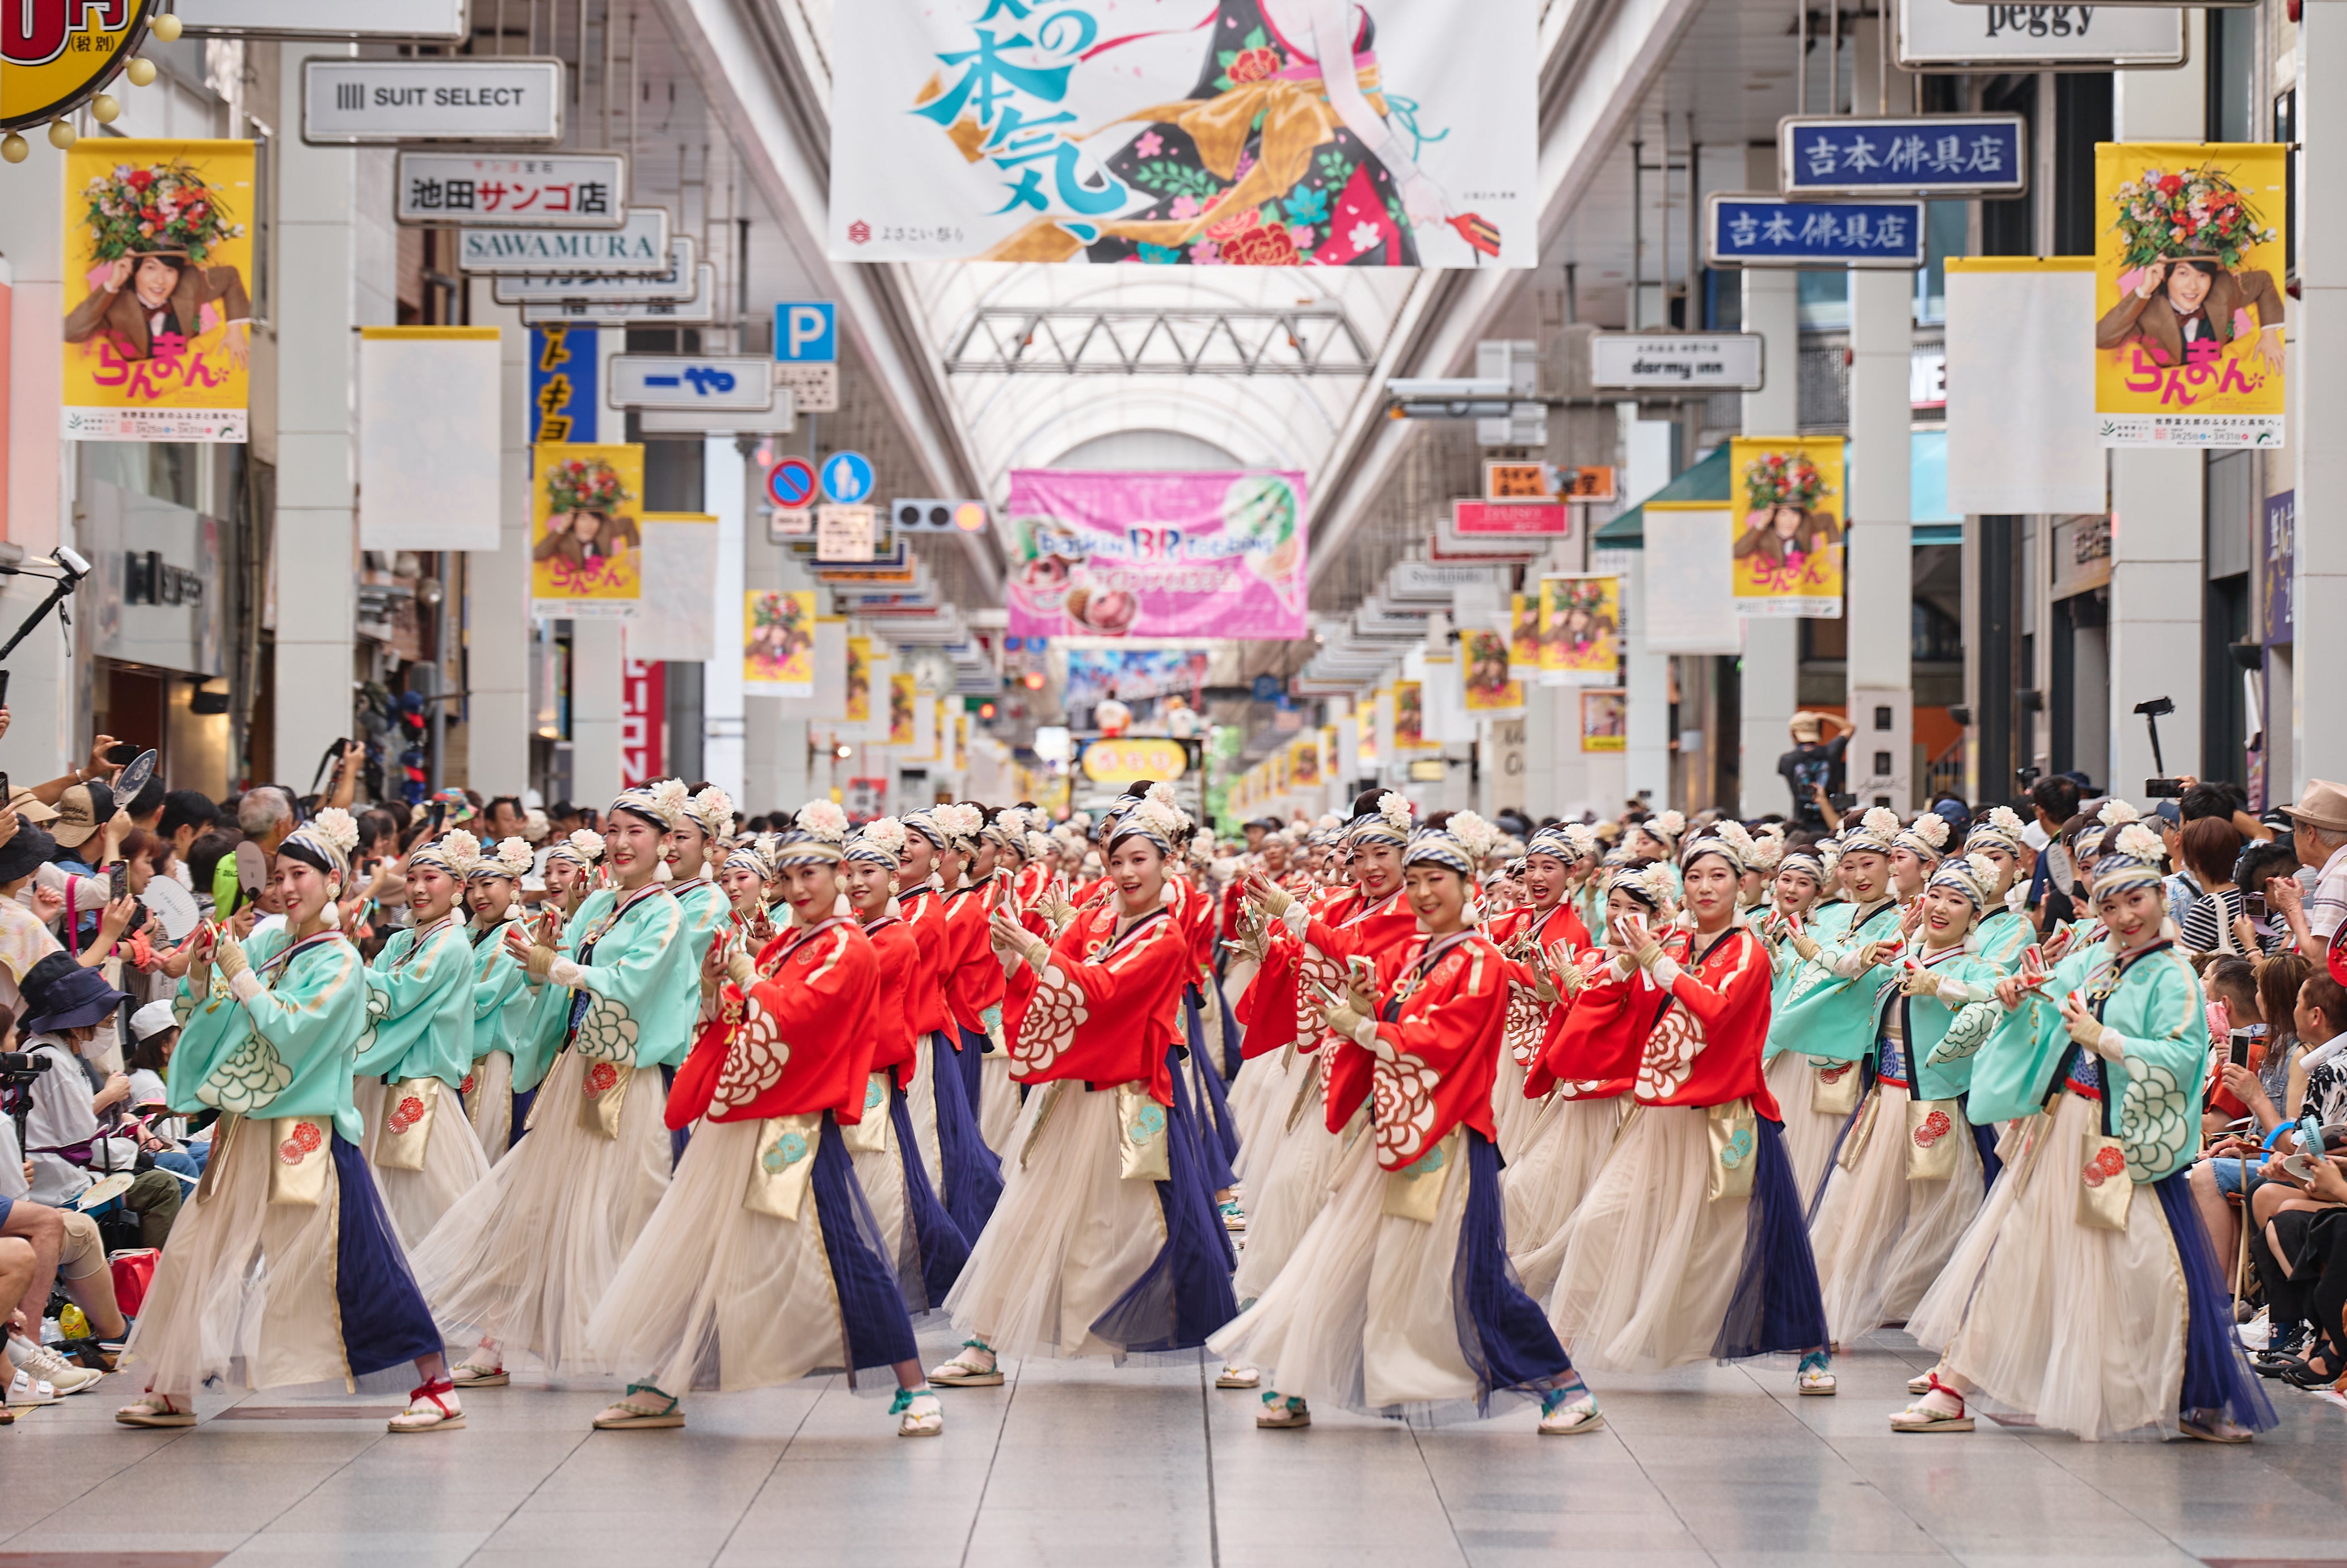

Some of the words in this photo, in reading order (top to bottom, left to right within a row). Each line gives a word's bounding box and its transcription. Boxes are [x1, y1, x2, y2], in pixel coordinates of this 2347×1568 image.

[1986, 5, 2093, 37] peggy
[71, 35, 115, 52] (税別)
[374, 88, 427, 107] SUIT
[435, 88, 525, 107] SELECT
[1805, 134, 2004, 177] 吉本佛具店
[411, 178, 608, 213] 池田サンゴ店
[466, 234, 655, 258] SAWAMURA
[1728, 210, 1908, 248] 吉本佛具店
[789, 307, 827, 359] P
[92, 331, 221, 399] らんまん
[2125, 337, 2258, 406] らんまん
